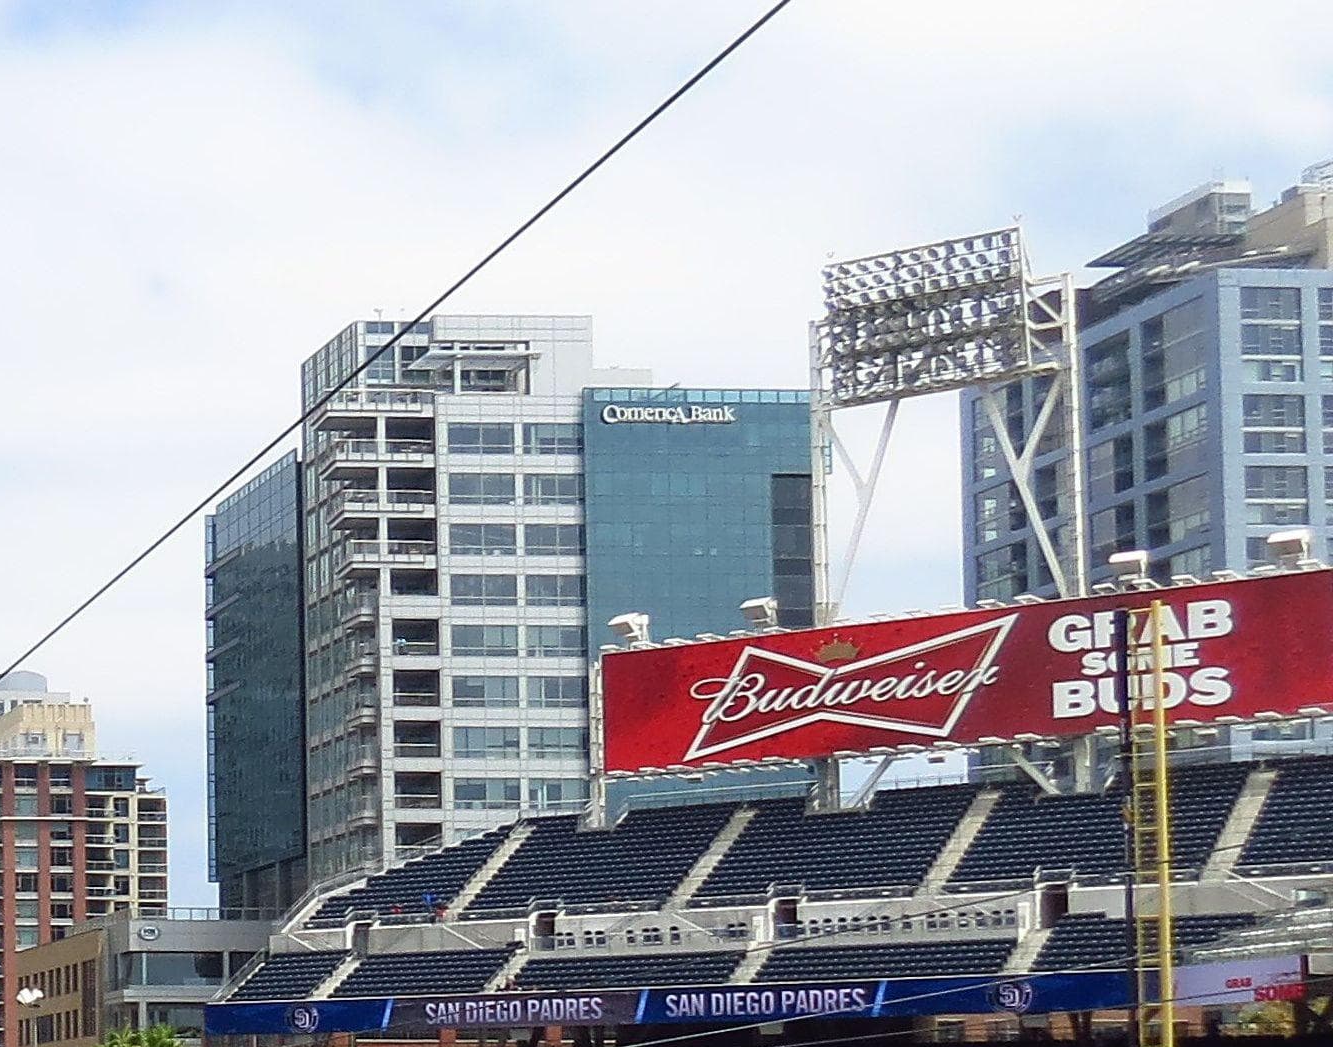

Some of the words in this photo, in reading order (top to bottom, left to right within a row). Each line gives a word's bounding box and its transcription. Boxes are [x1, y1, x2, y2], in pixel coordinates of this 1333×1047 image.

[690, 405, 736, 421] Bank
[690, 661, 1000, 725] Budweiser
[424, 1002, 461, 1024] SAN
[466, 1000, 522, 1023] DIEGO
[527, 996, 604, 1021] PADRES
[665, 993, 705, 1018] SAN
[710, 991, 775, 1017] DIEGO
[781, 987, 867, 1014] PADRES
